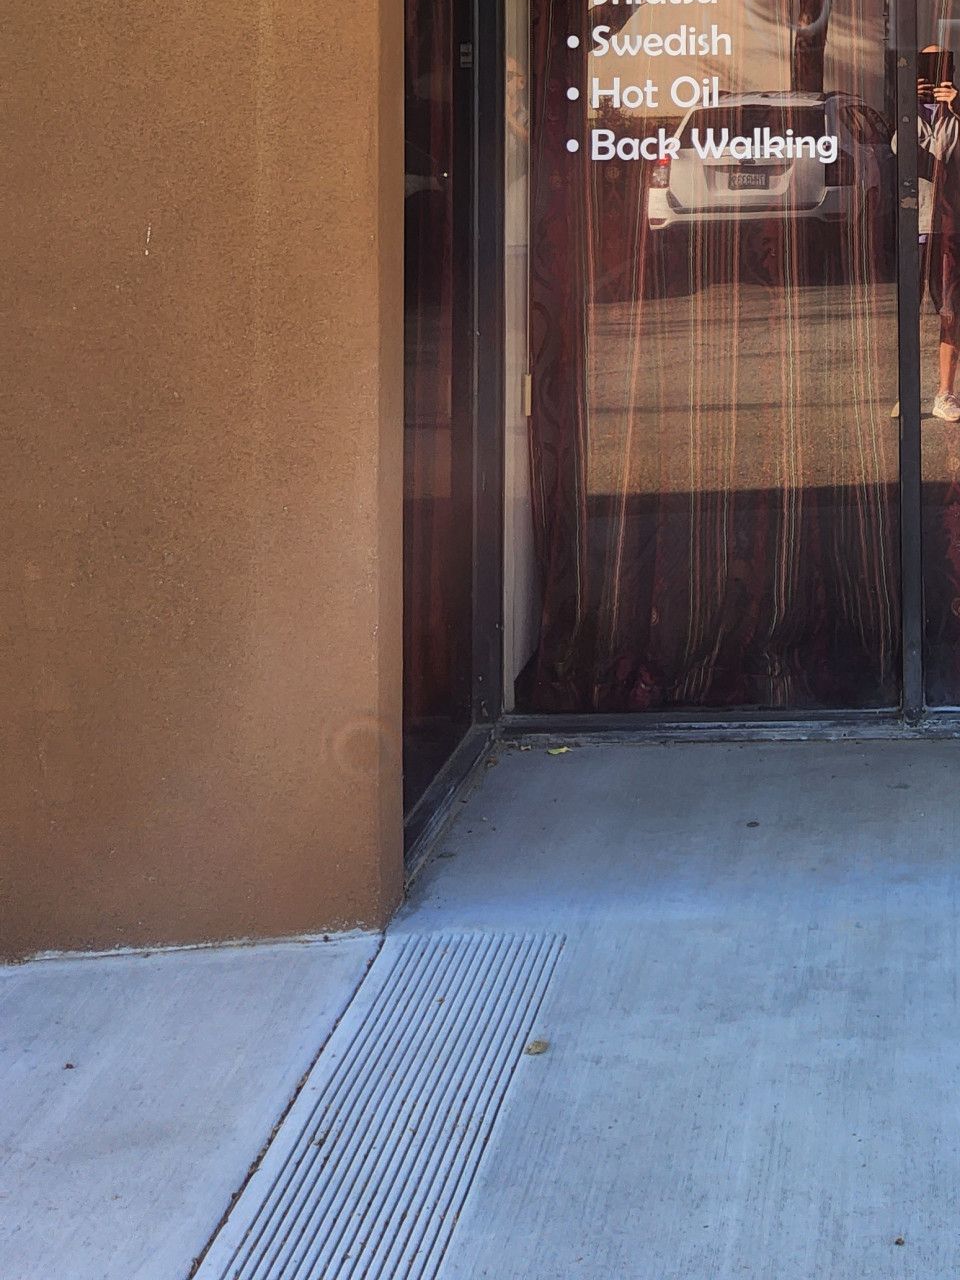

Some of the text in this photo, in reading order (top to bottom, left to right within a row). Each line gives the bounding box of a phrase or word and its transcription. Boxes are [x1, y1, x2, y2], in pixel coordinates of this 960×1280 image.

[590, 25, 733, 57] Swedish
[591, 75, 719, 109] Hot Oil
[590, 127, 839, 164] Back Walking
